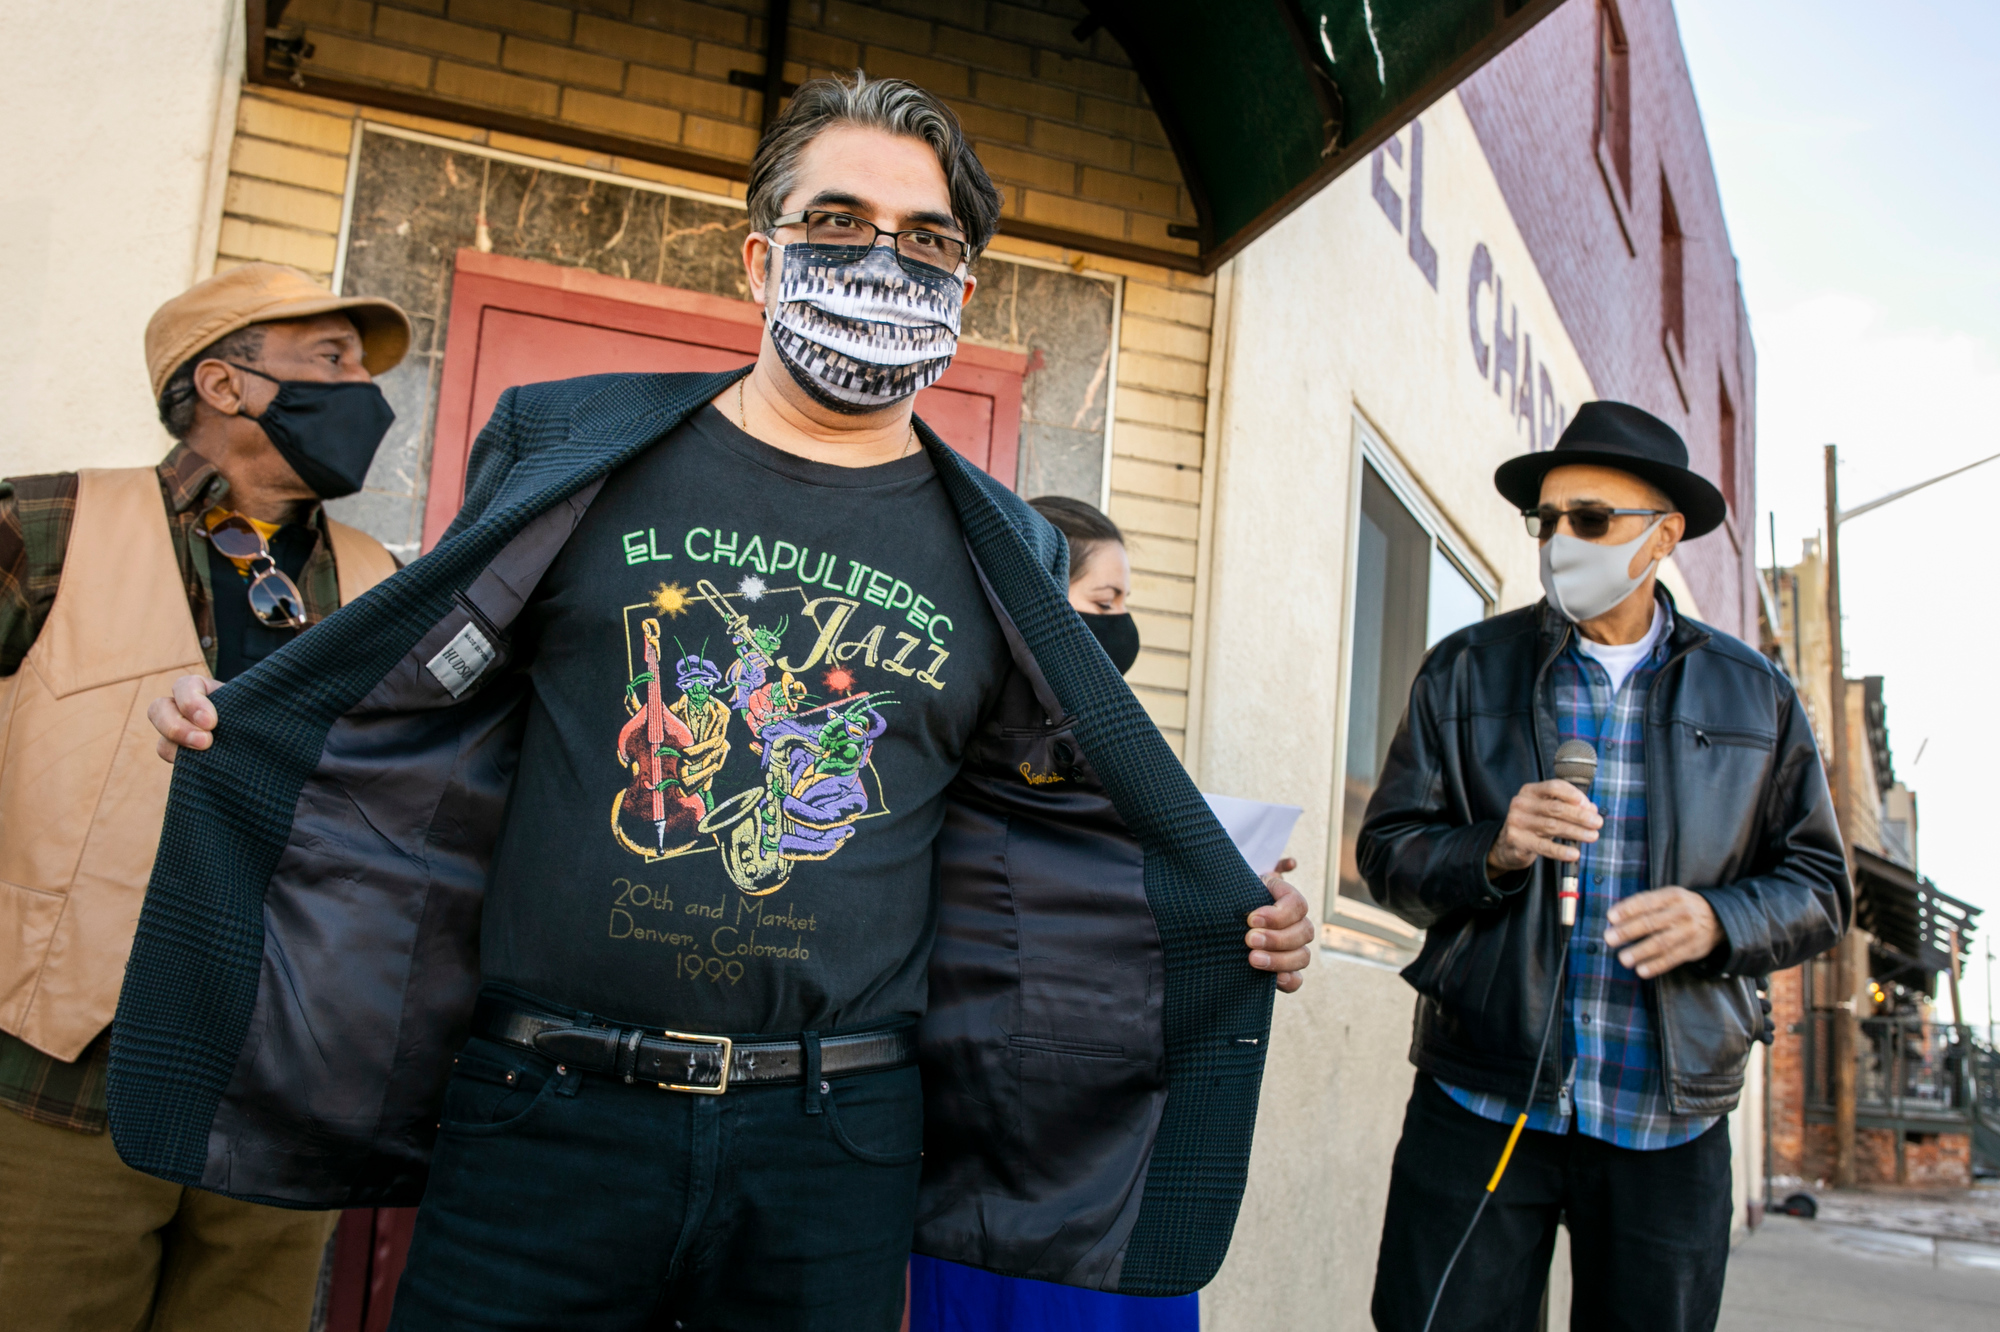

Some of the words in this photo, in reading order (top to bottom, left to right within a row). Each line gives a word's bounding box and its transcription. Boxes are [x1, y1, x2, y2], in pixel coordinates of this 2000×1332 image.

[622, 527, 673, 566] EL
[684, 527, 953, 645] CHAPULTEPEC
[776, 596, 950, 690] JAZZ
[612, 877, 674, 911] 20th
[684, 893, 726, 919] and
[736, 895, 817, 931] Market
[609, 907, 700, 950] Denver,
[711, 925, 810, 960] Colorado
[677, 952, 745, 986] 1999
